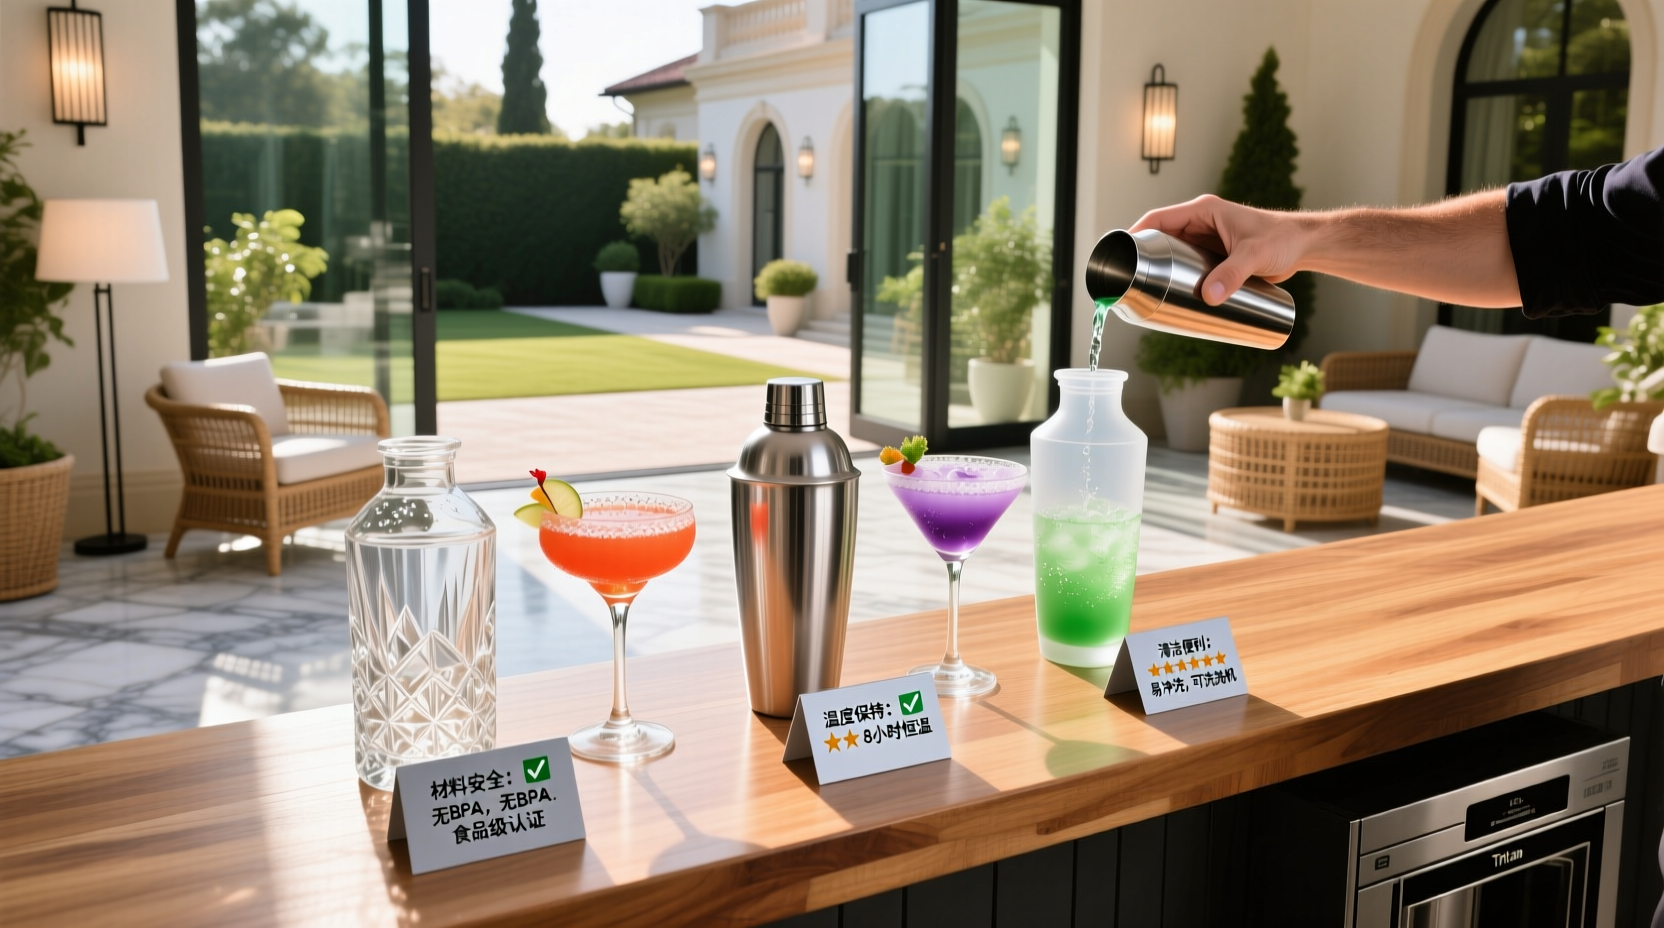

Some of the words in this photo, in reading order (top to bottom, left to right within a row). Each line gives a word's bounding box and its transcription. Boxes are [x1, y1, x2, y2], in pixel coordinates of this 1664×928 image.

[431, 769, 512, 800] 材料安全：
[452, 810, 546, 844] 食品级认证
